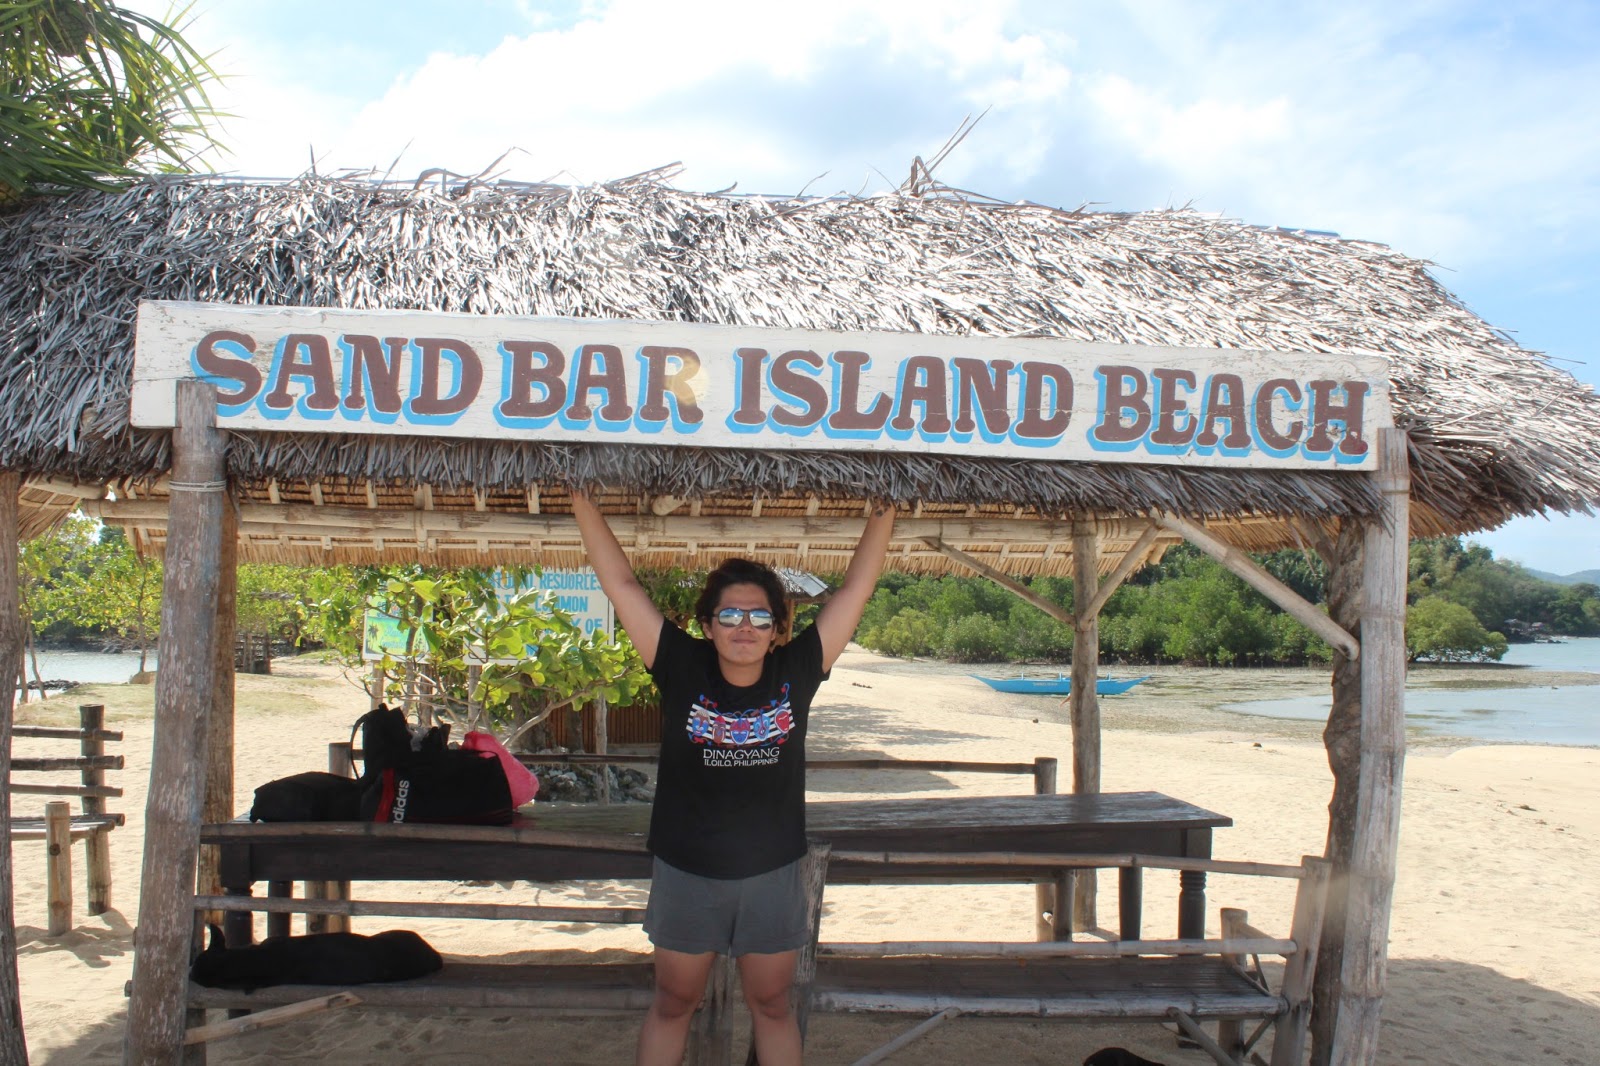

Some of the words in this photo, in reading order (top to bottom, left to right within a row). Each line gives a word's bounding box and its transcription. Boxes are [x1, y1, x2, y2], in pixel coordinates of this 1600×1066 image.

[192, 330, 483, 425] SAND
[495, 341, 704, 433] BAR
[727, 348, 1074, 445] ISLAND
[1087, 365, 1371, 464] BEACH
[703, 747, 780, 760] DINAGYANG
[733, 757, 779, 767] PHILIPPINES
